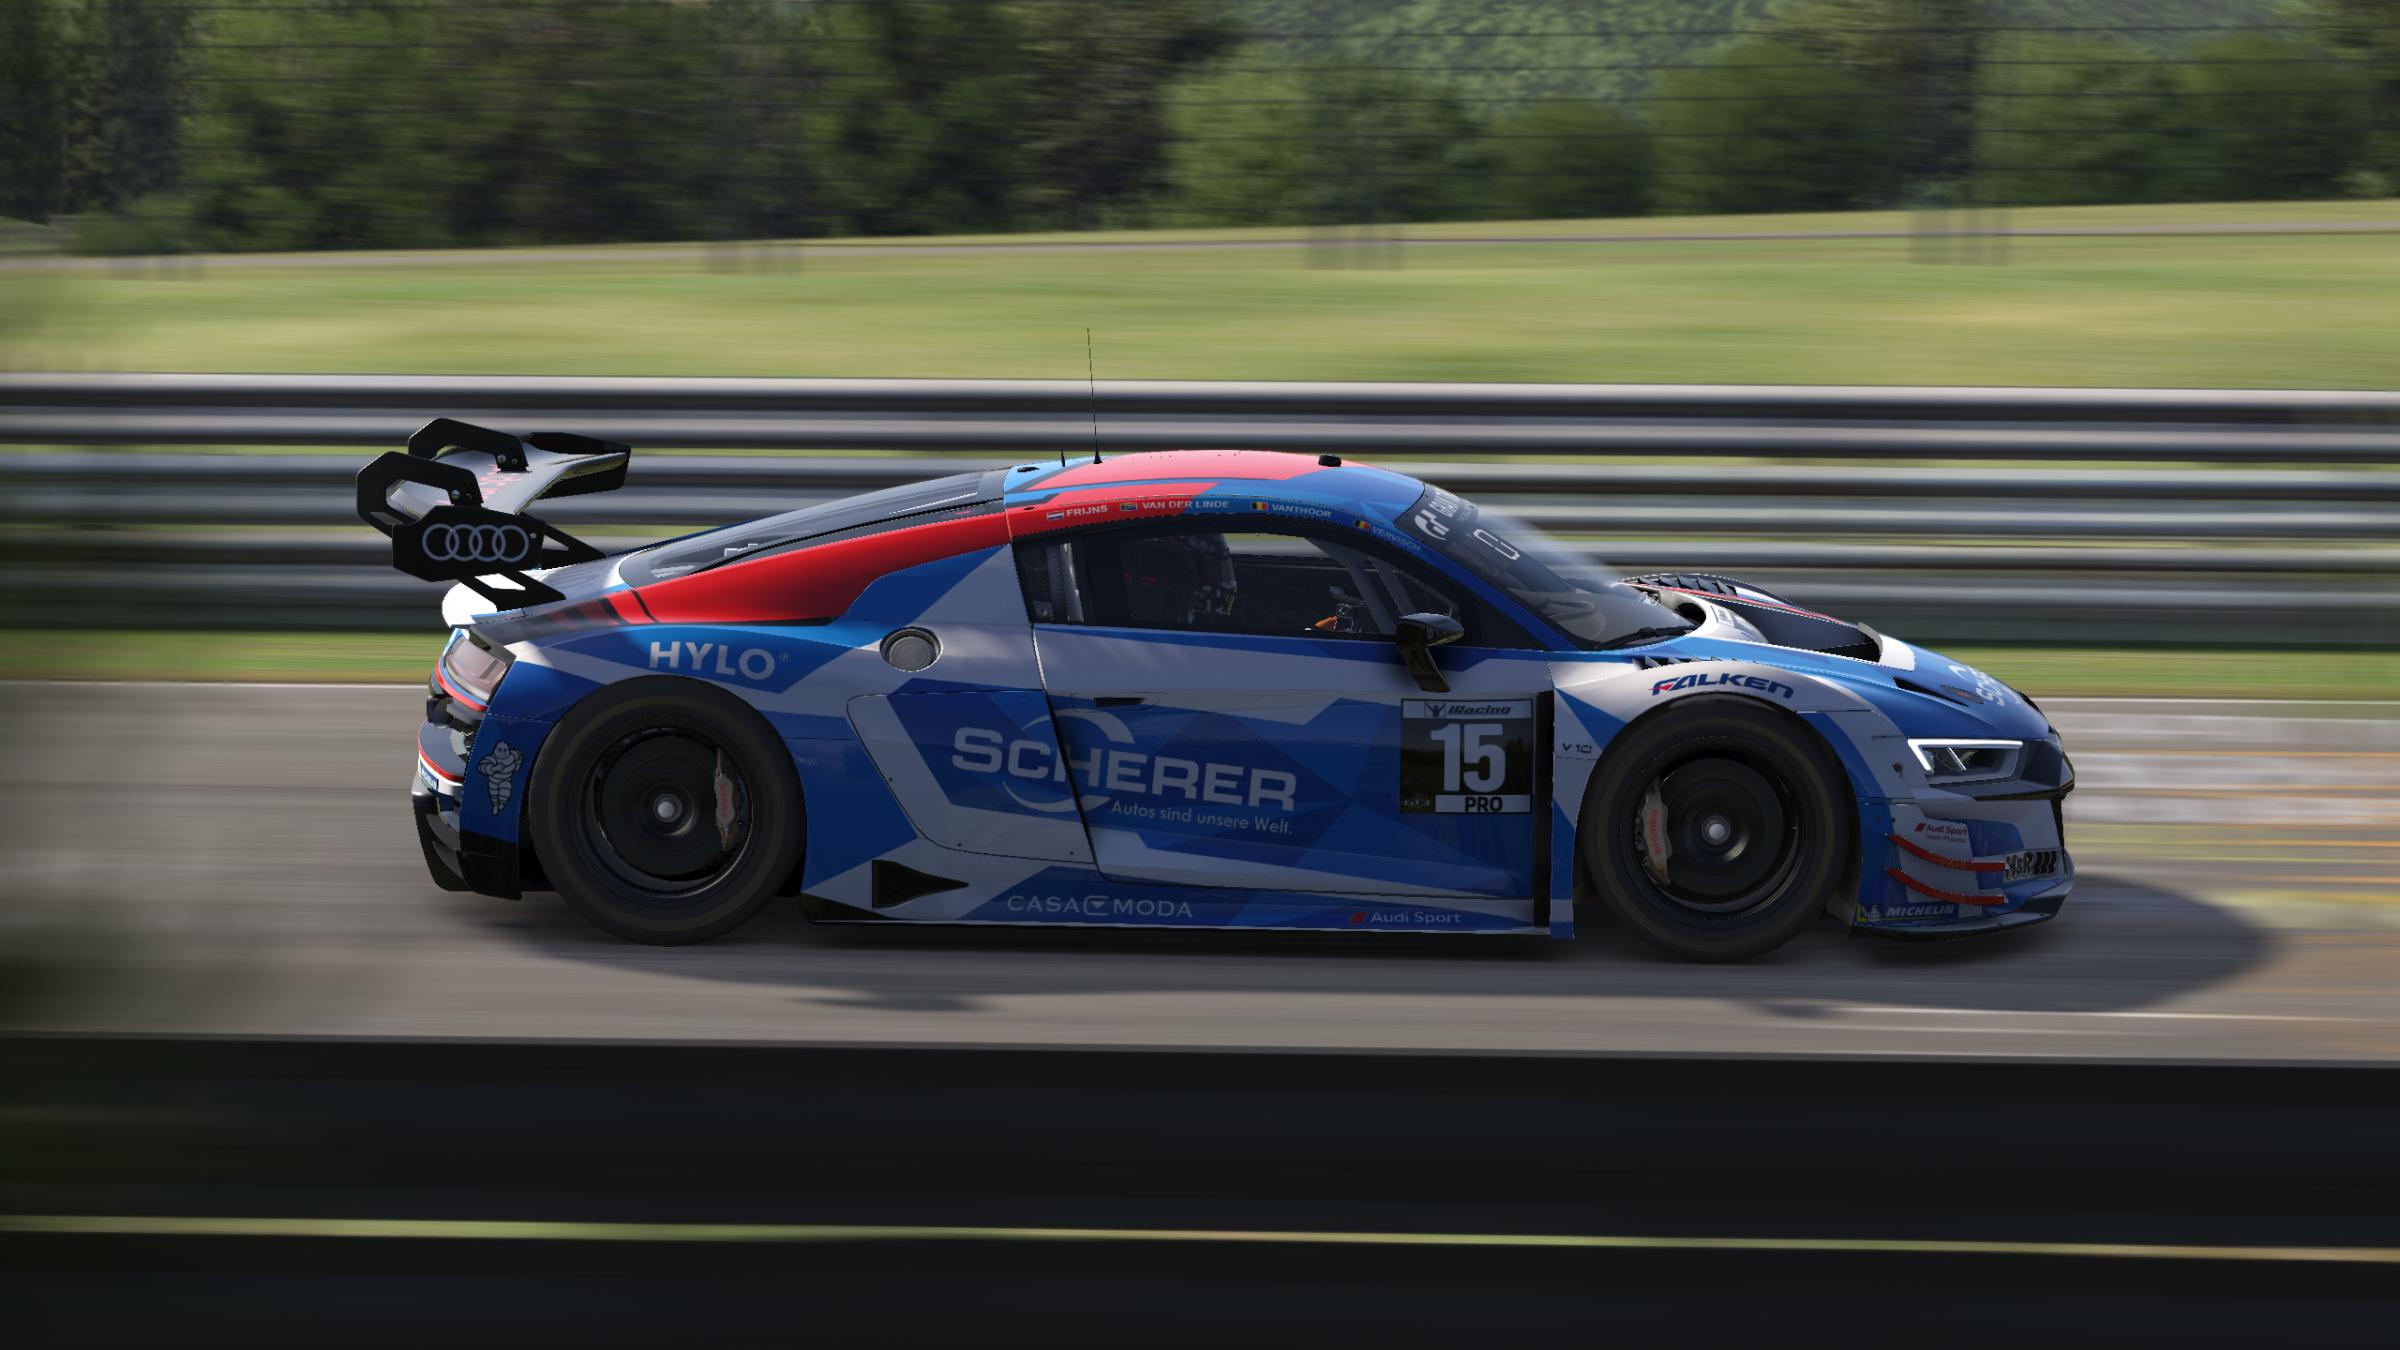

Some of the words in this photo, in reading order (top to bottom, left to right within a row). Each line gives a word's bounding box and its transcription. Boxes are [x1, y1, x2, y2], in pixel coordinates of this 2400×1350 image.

[1066, 505, 1109, 517] FRIJNS
[1168, 500, 1193, 508] DER
[1196, 500, 1230, 508] LINDE
[1272, 503, 1332, 518] VANTHOOR
[650, 641, 776, 681] HYLO
[1648, 673, 1794, 699] FALKEN
[1430, 723, 1506, 793] 15
[951, 726, 1297, 811] SCHERER
[1465, 797, 1503, 812] PRO
[1111, 800, 1156, 820] Autos
[1159, 806, 1192, 824] sind
[1196, 812, 1249, 829] unsere
[1254, 816, 1293, 835] Welt.
[1926, 824, 1944, 833] Audi
[1946, 826, 1968, 836] Sport
[1007, 894, 1085, 912] CASA
[1113, 899, 1193, 918] MODA
[1886, 905, 1954, 917] MICHELIN
[1371, 911, 1409, 923] Audi
[1414, 911, 1461, 925] Sport
